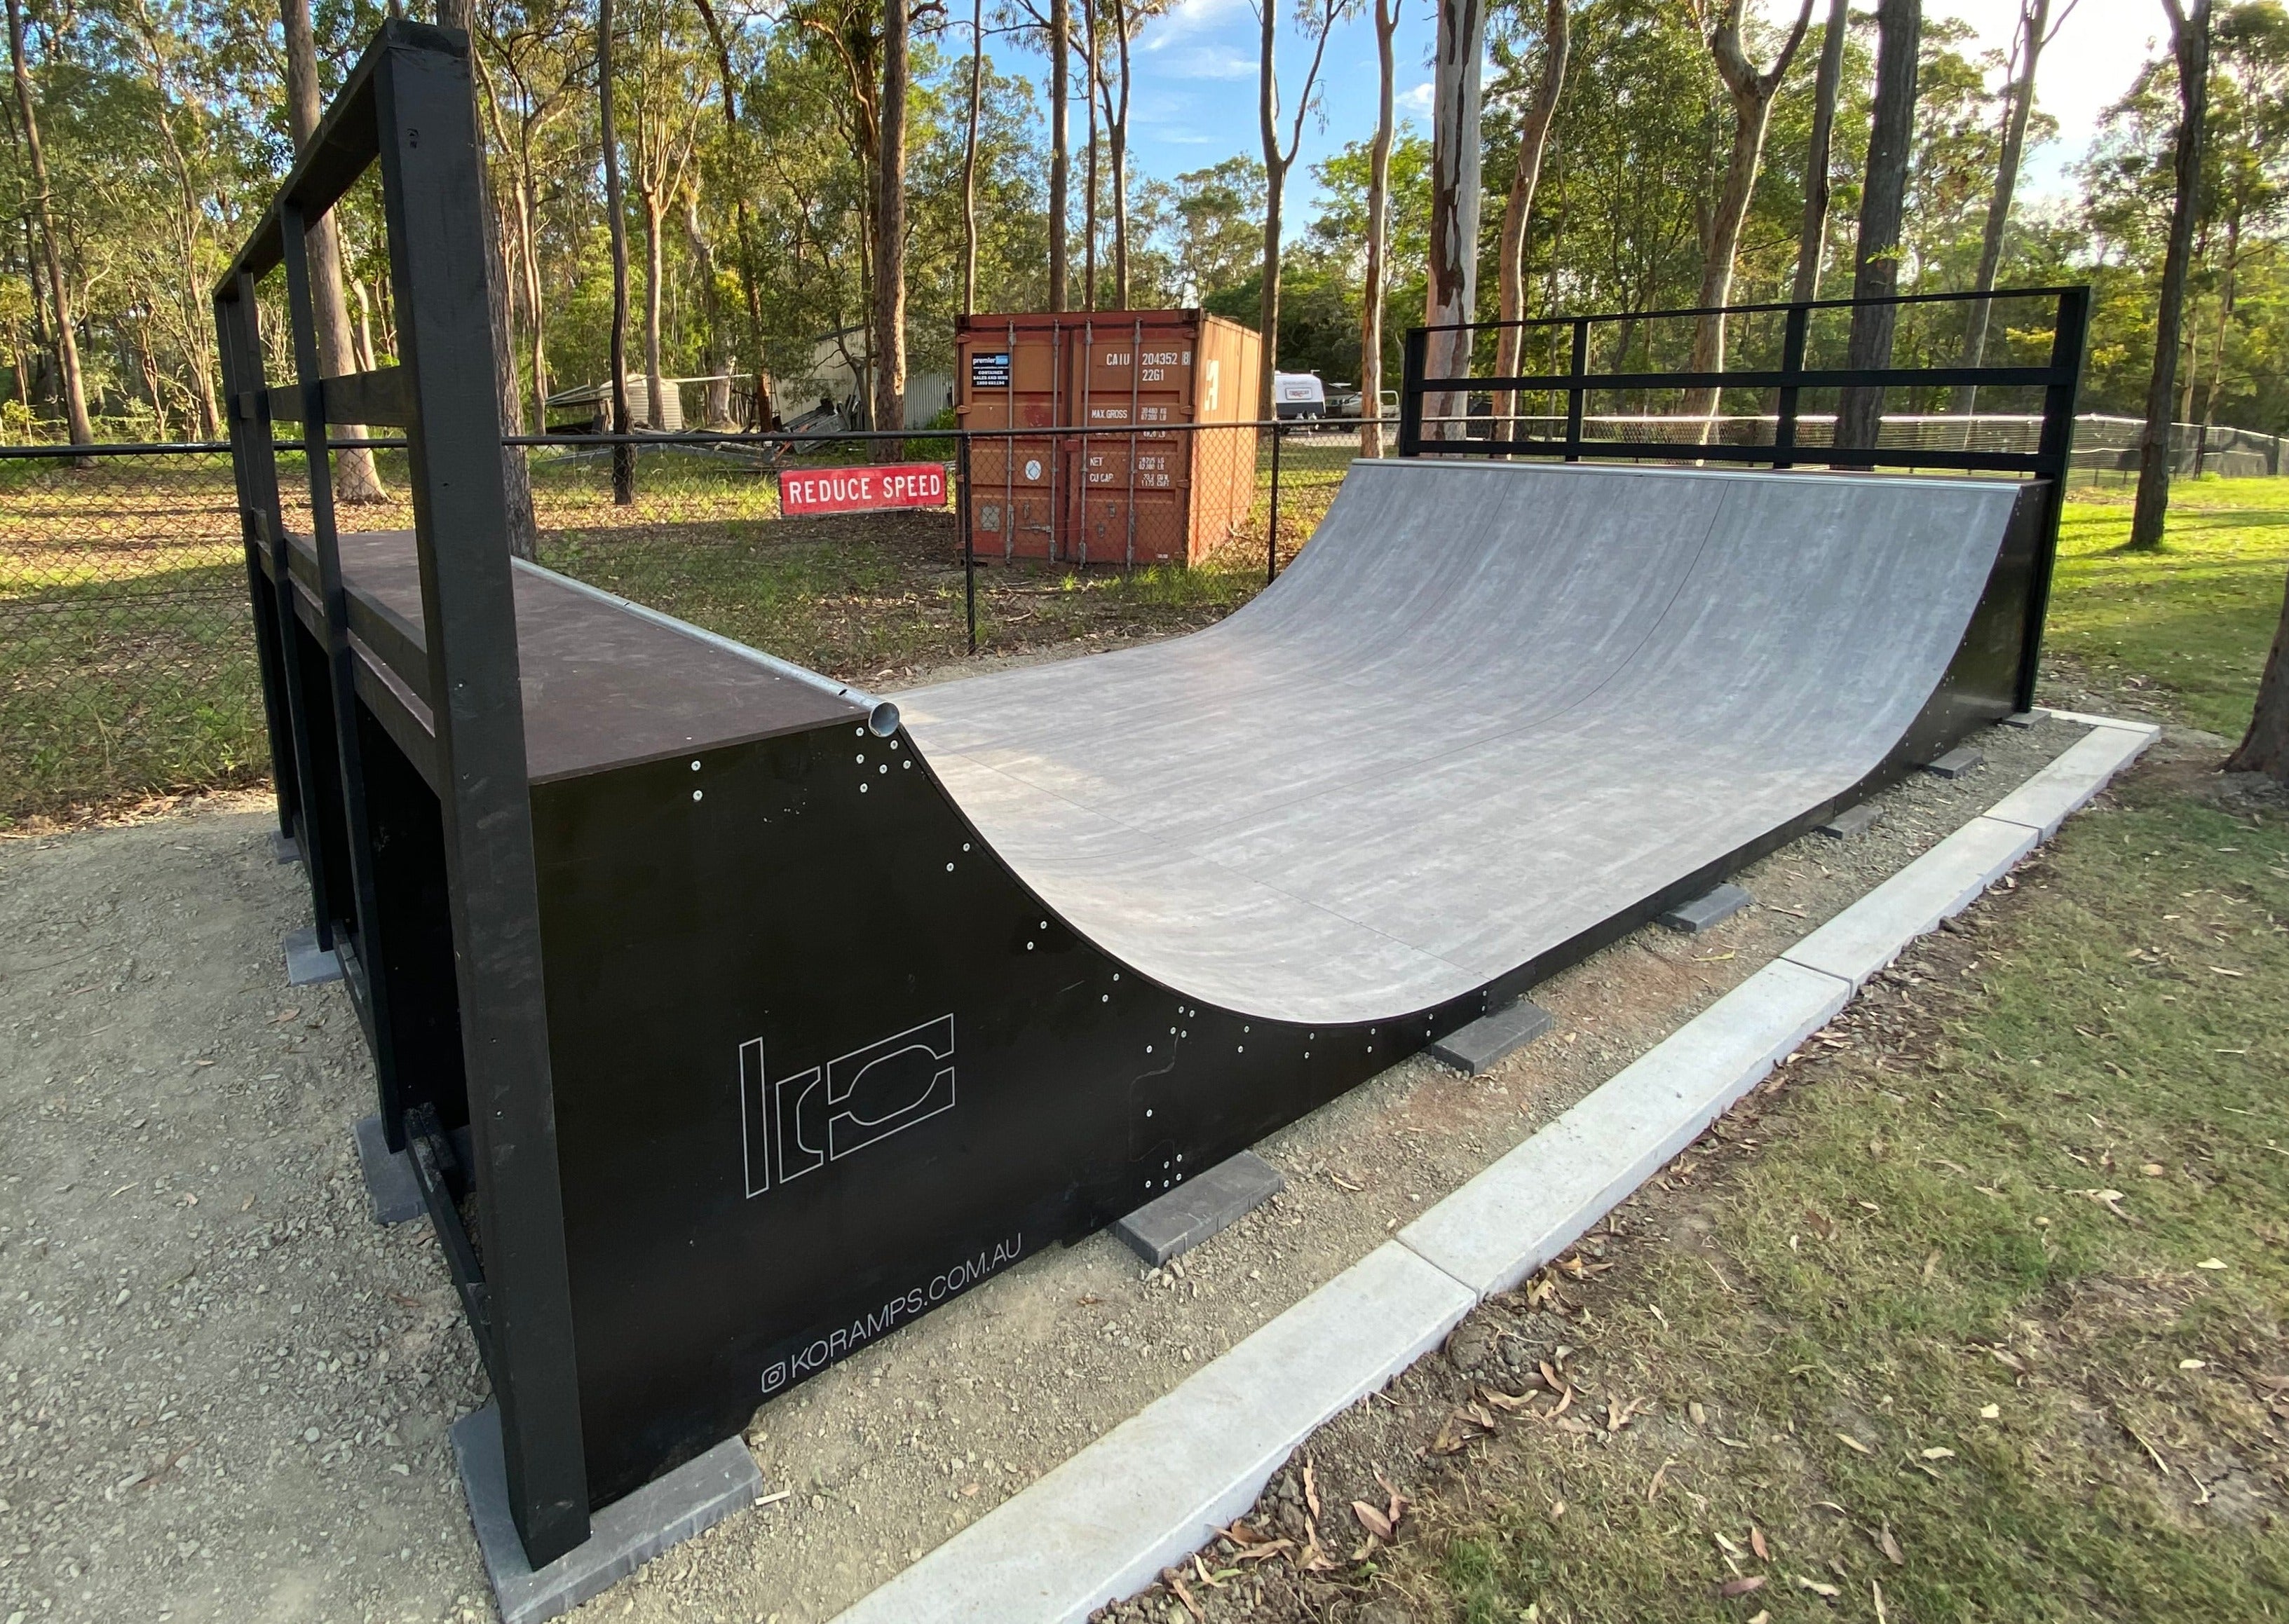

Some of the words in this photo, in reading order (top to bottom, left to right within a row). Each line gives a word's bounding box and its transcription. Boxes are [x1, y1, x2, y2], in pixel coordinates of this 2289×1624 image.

[1106, 353, 1130, 366] CAIU
[1141, 352, 1178, 366] 204352
[1182, 352, 1190, 365] 8
[1142, 369, 1164, 381] 22G1
[1089, 456, 1103, 466] NET
[789, 477, 872, 504] REDUCE
[883, 475, 941, 498] SPEED
[791, 1232, 1022, 1379] KORAMPS.COM.AU
